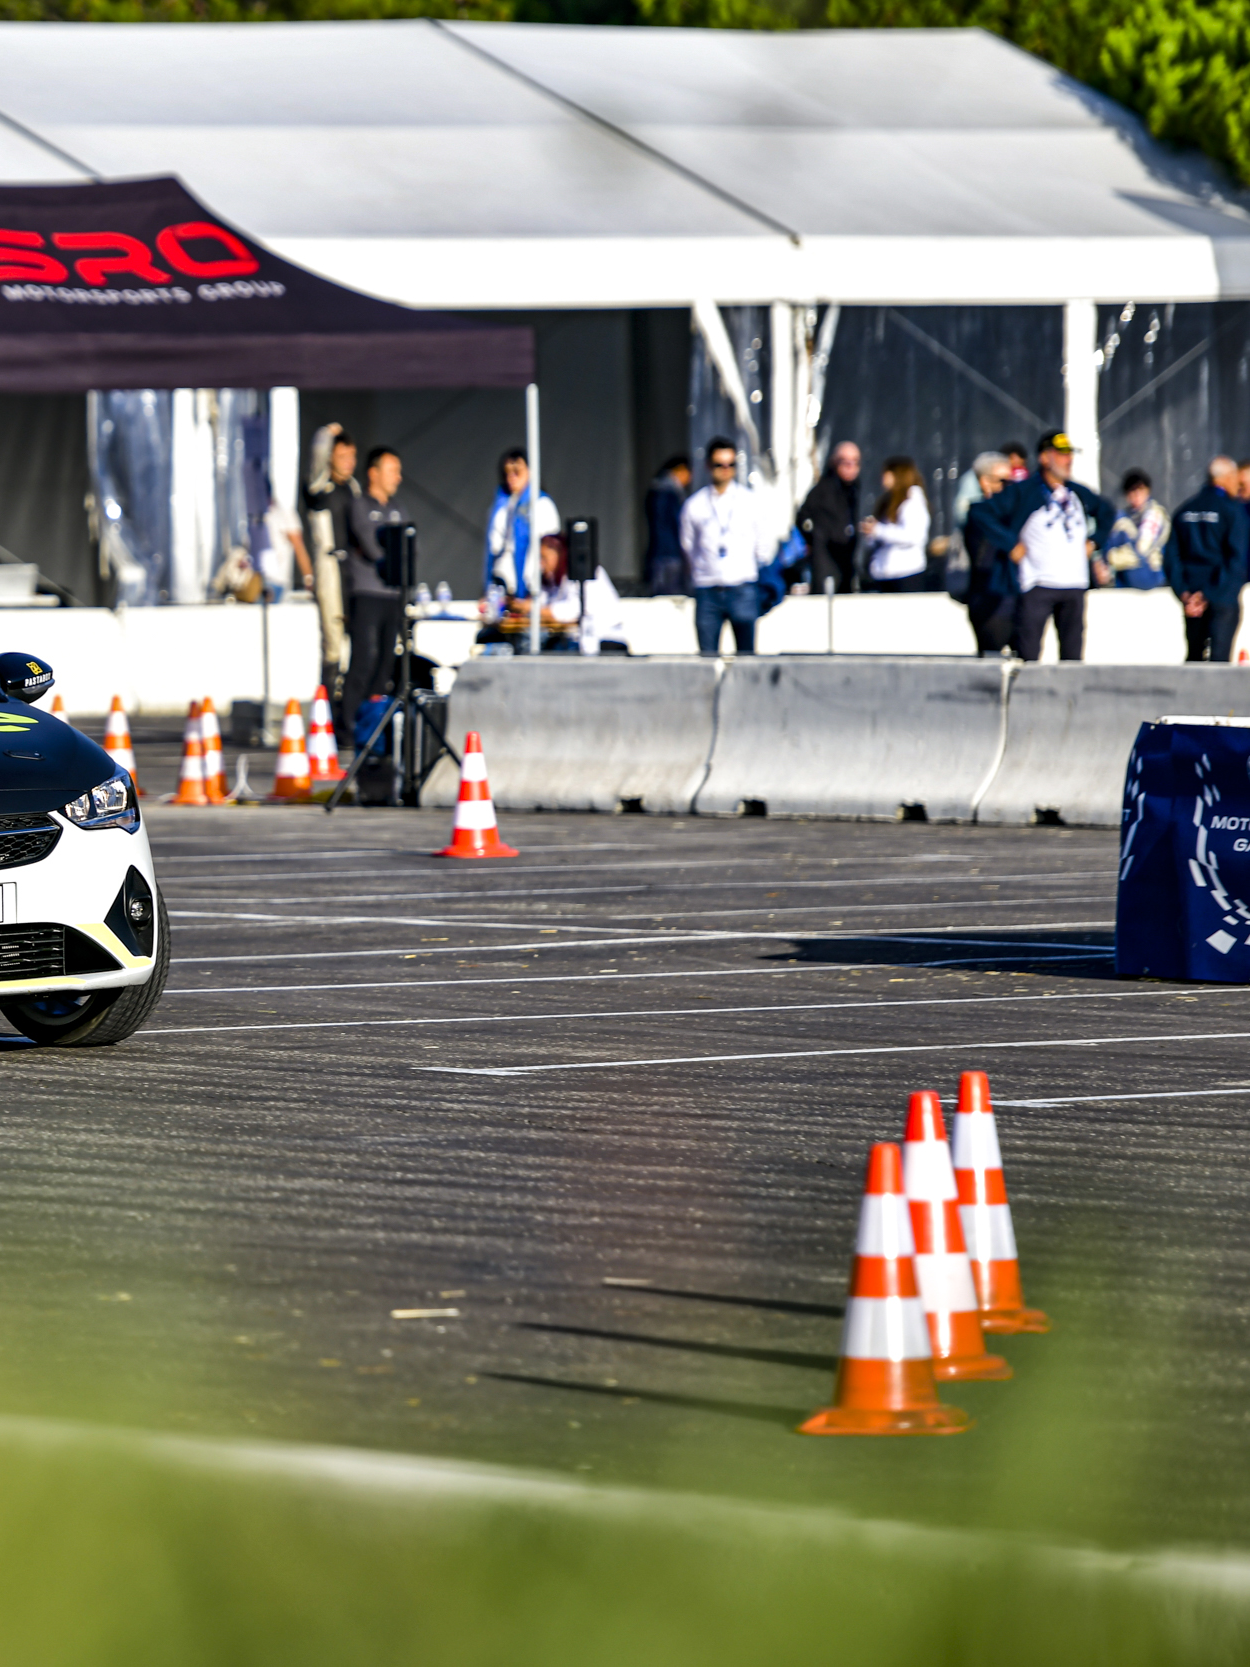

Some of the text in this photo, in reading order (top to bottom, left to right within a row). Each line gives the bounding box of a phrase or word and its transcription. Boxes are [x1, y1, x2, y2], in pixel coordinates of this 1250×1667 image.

[1, 279, 287, 305] MOTORSPORTS GROUP
[1210, 815, 1250, 831] MOT
